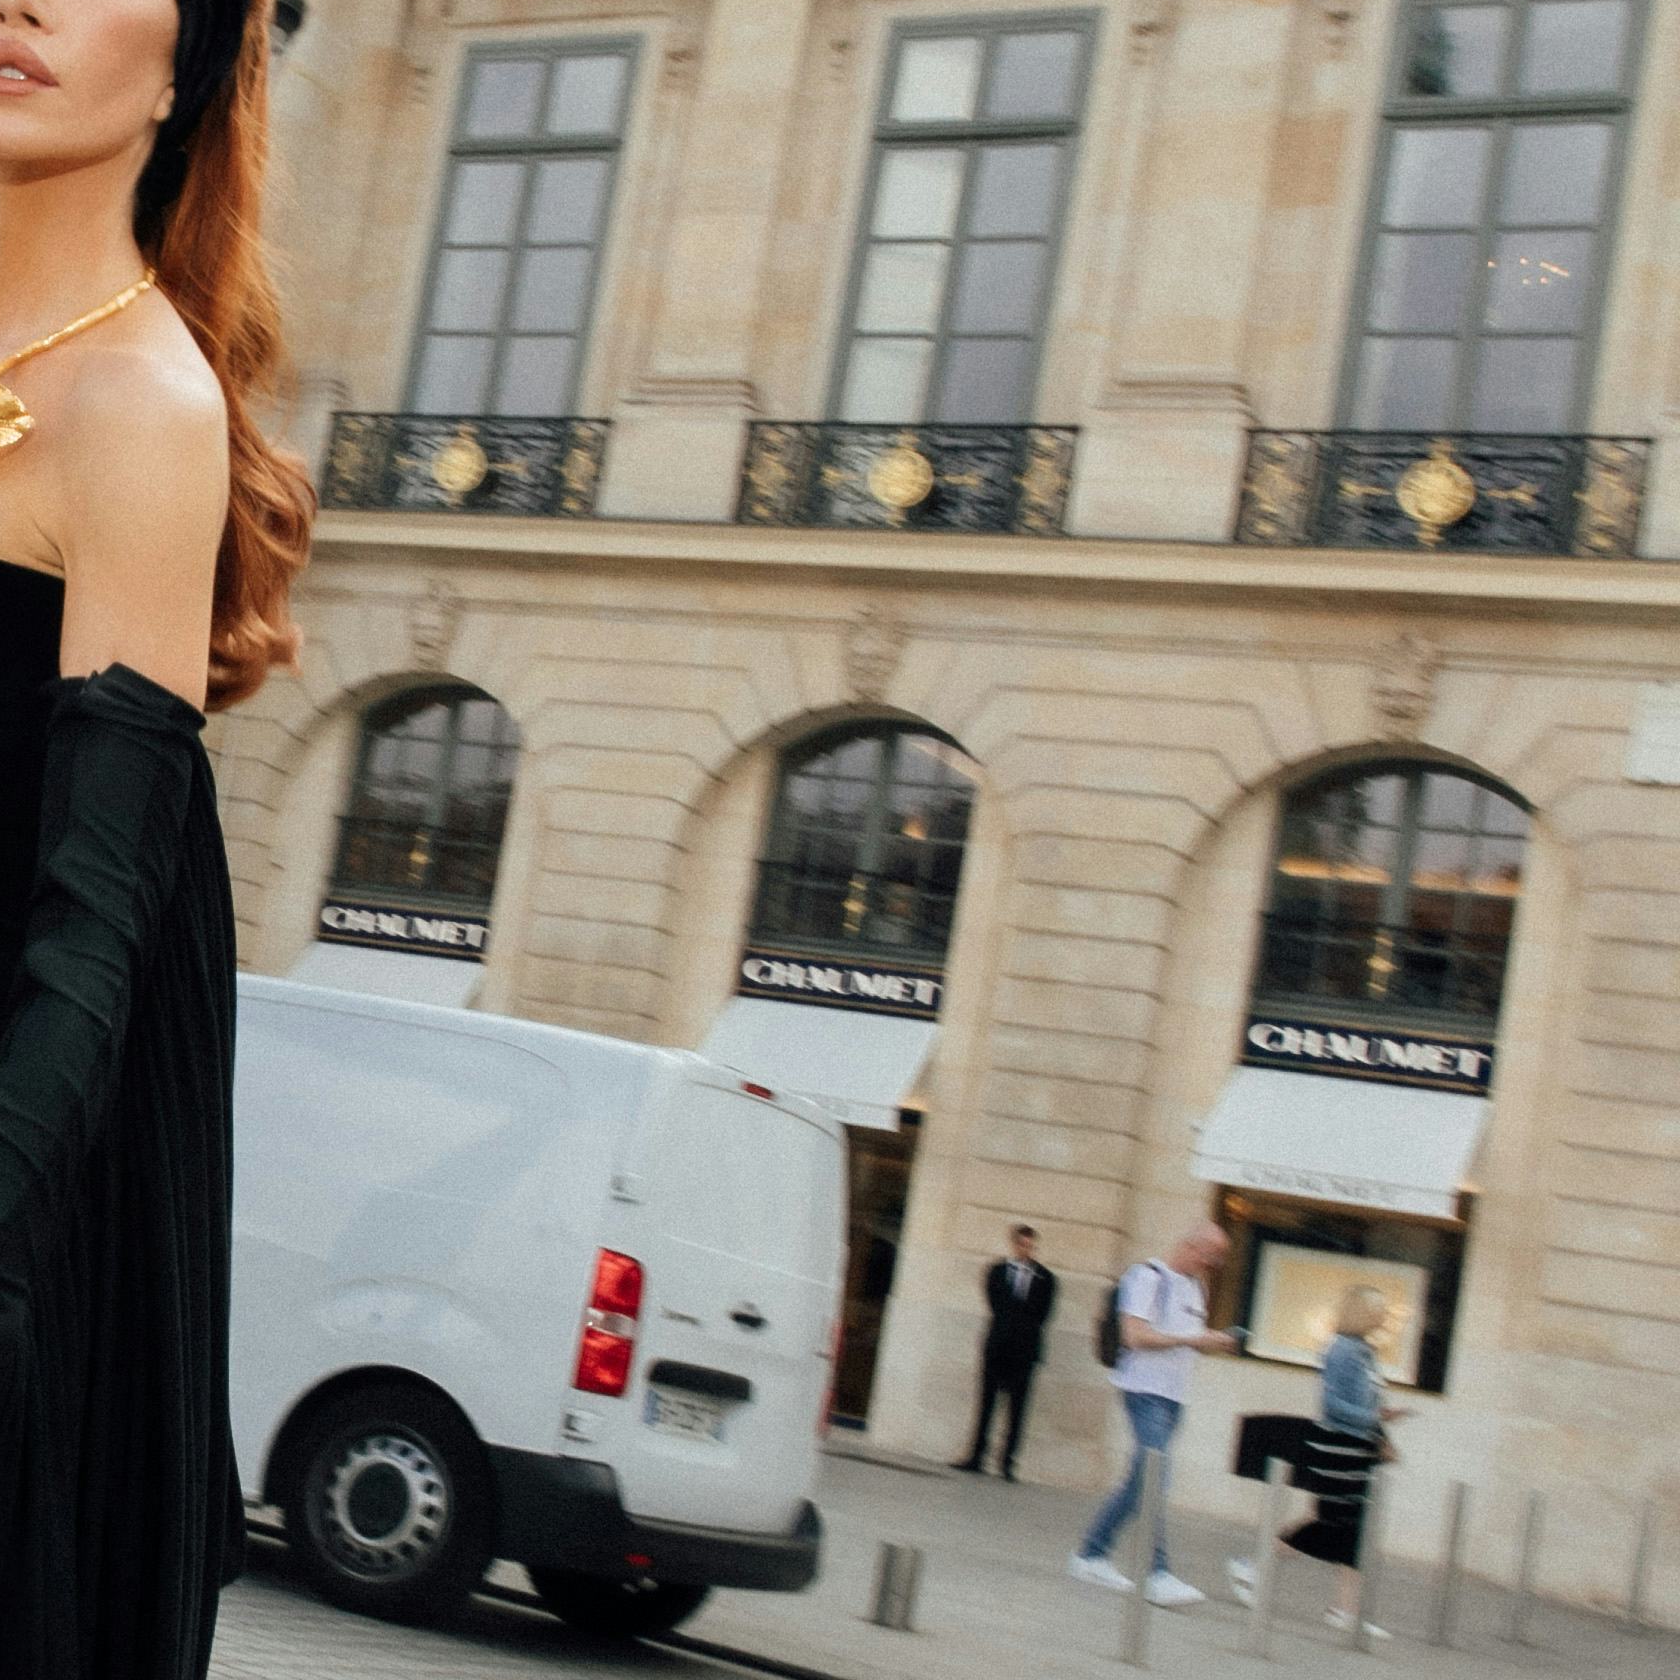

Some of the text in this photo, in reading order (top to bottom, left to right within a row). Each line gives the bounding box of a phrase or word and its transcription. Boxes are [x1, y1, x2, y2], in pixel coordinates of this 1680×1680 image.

[321, 906, 490, 948] CHAUMET
[742, 959, 944, 1005] CHAUMET
[1248, 1023, 1492, 1078] CHAUMET
